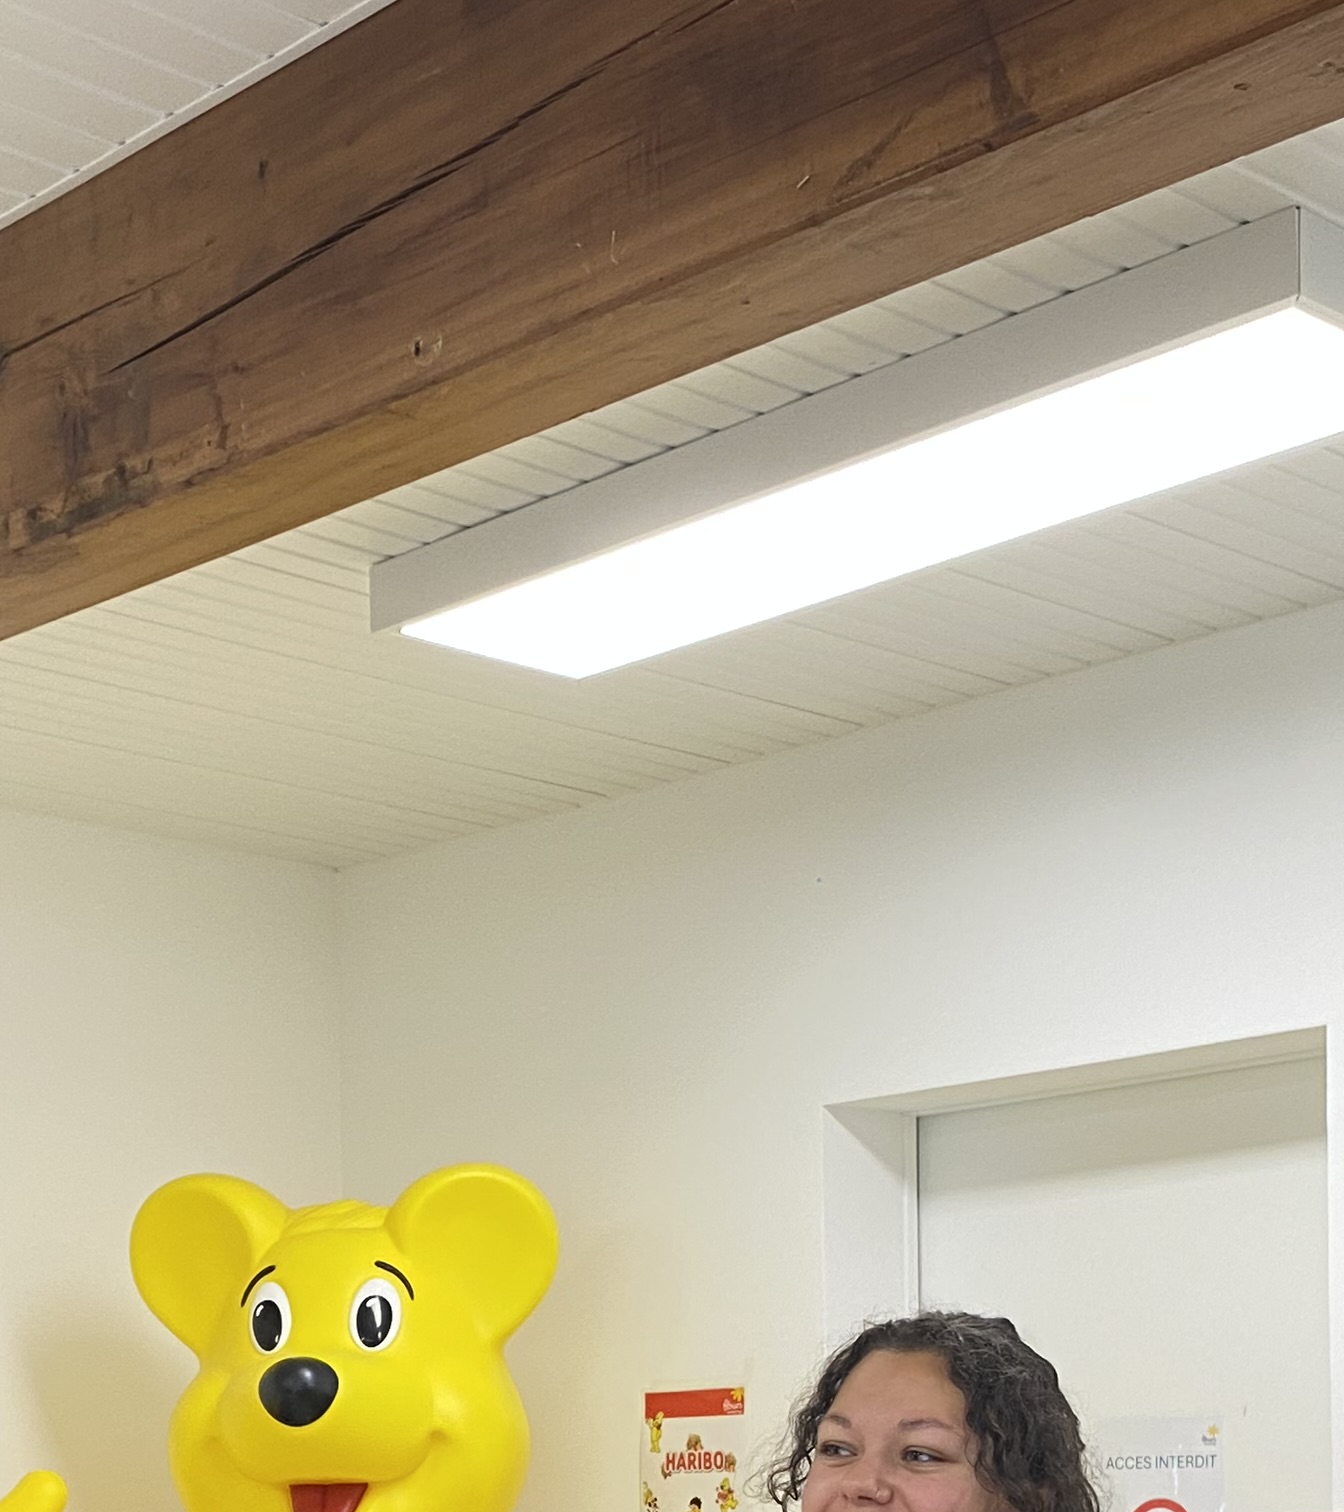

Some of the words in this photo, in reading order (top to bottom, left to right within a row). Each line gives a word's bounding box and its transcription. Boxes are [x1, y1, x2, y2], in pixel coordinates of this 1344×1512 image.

[665, 1451, 726, 1472] HARIBO
[1106, 1456, 1152, 1470] ACCES
[1155, 1454, 1218, 1469] INTERDIT
